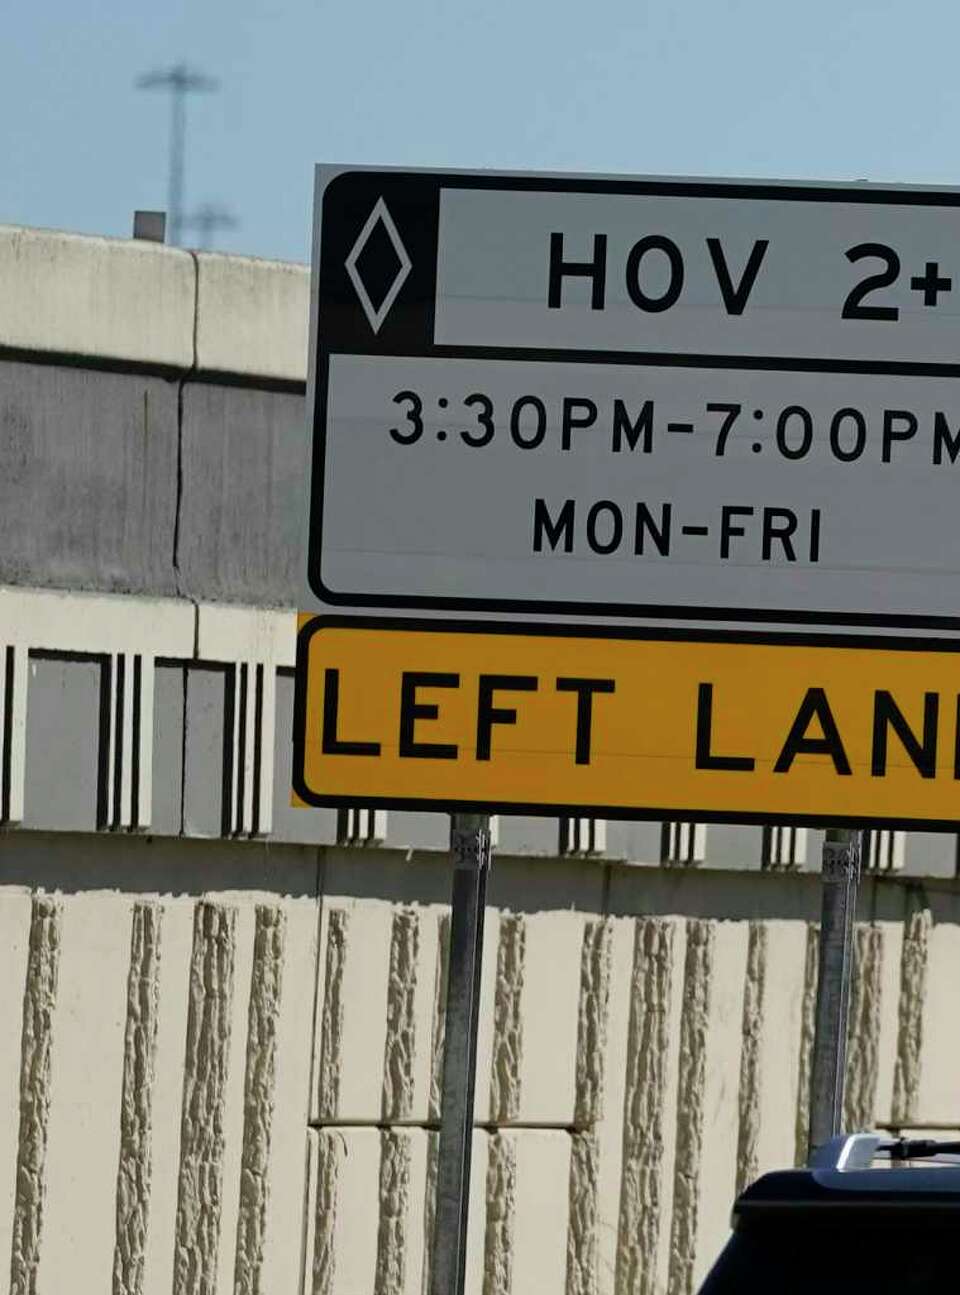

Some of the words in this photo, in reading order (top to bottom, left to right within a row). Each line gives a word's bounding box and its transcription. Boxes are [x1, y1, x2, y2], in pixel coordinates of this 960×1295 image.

[546, 231, 770, 316] HOV
[840, 242, 952, 322] 2+
[532, 498, 822, 563] MON-FRI
[320, 667, 616, 766] LEFT
